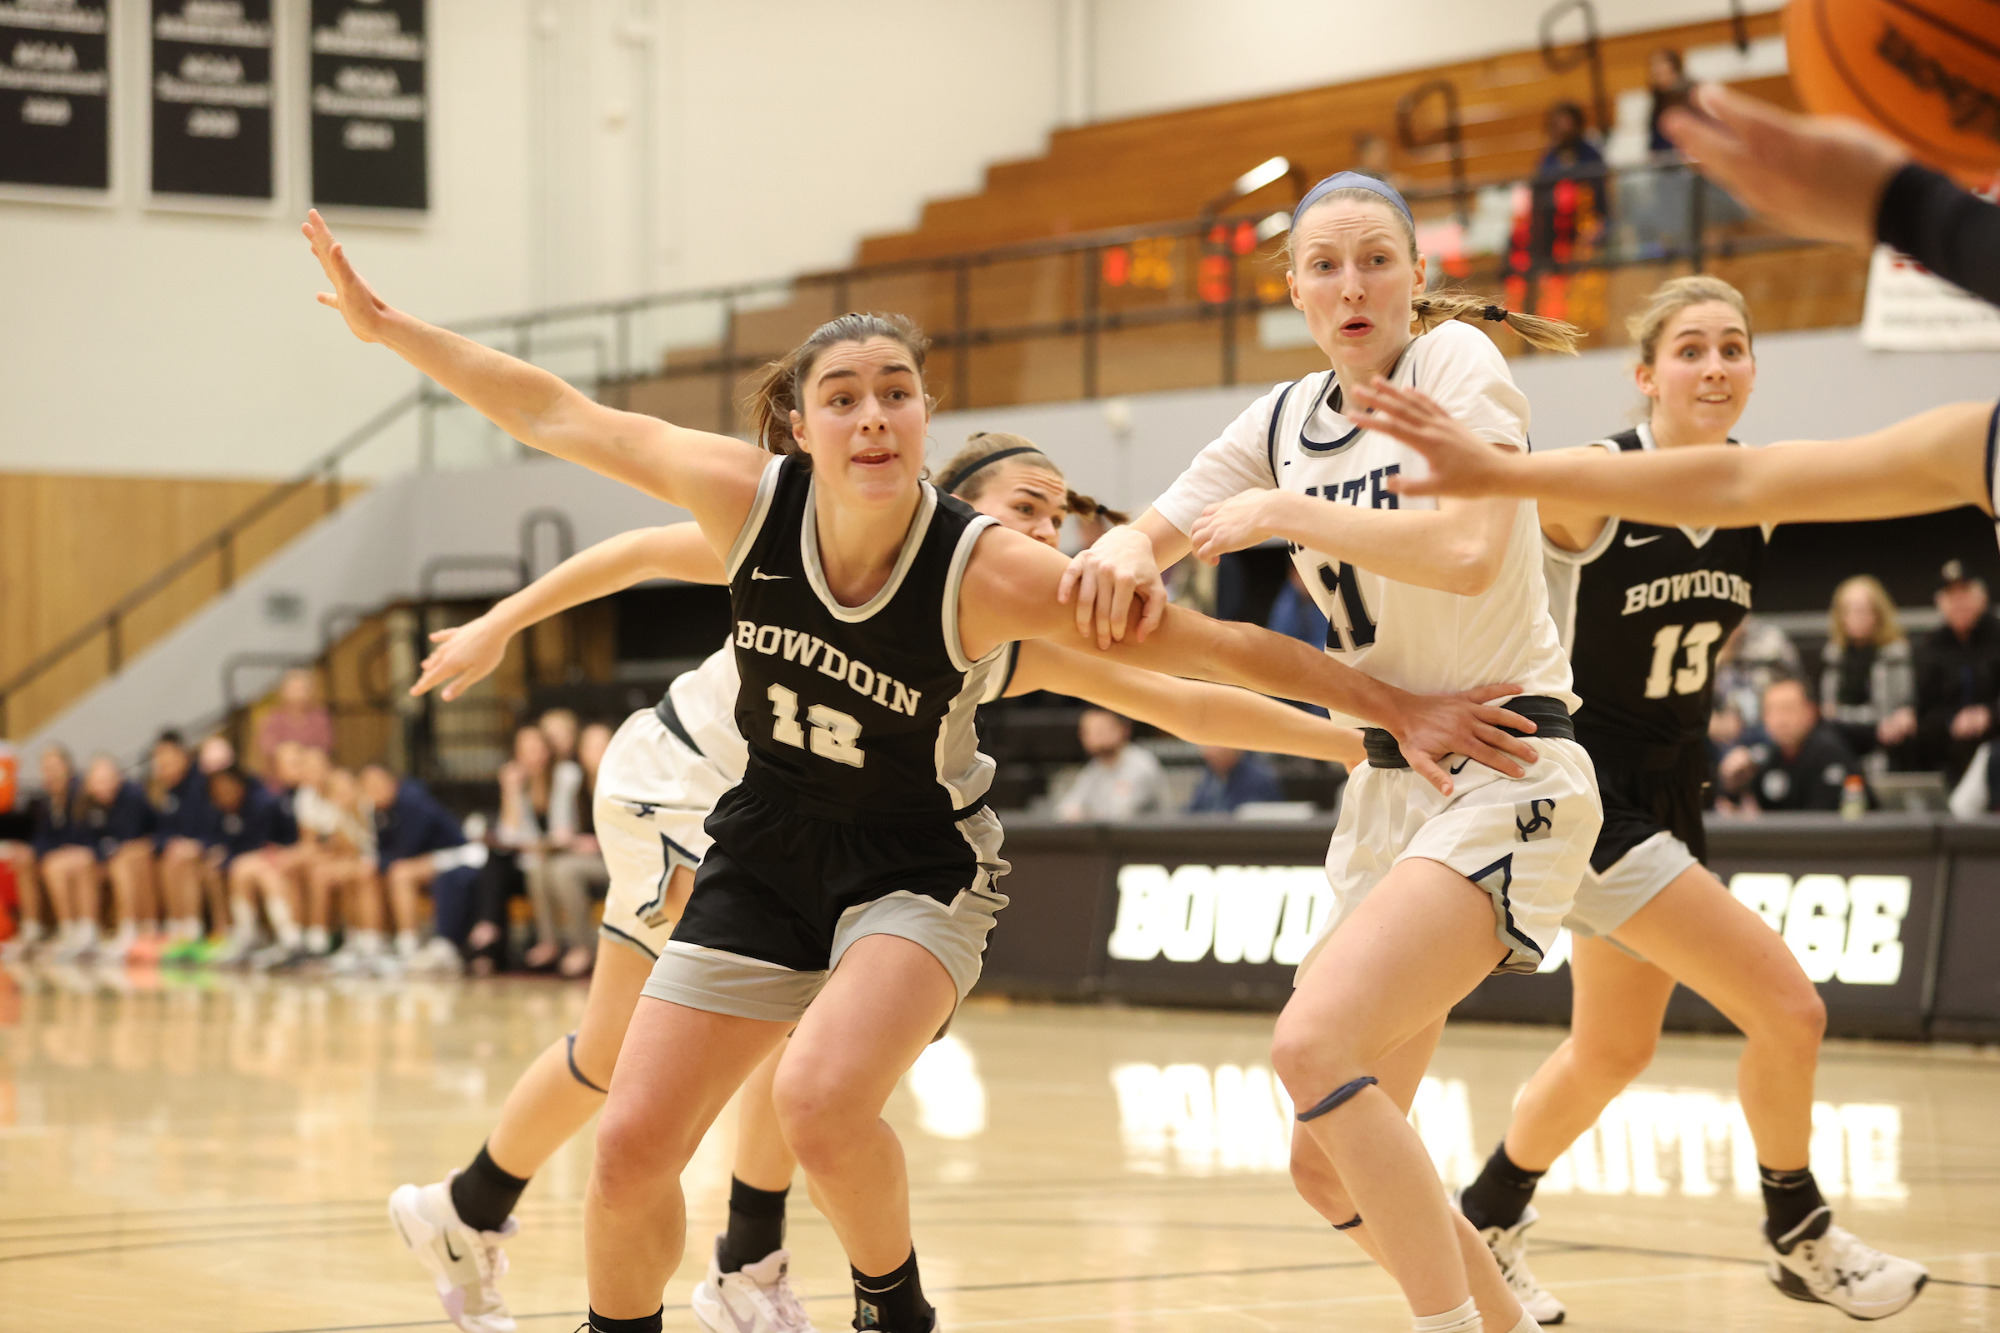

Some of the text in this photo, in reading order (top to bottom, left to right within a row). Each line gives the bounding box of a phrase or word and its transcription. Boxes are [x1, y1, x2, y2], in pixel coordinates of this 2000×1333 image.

[1621, 569, 1752, 616] BOWDOIN
[735, 620, 921, 717] BOWDOIN
[1644, 620, 1723, 699] 13
[767, 682, 866, 769] 12
[1107, 864, 1337, 966] BOWD
